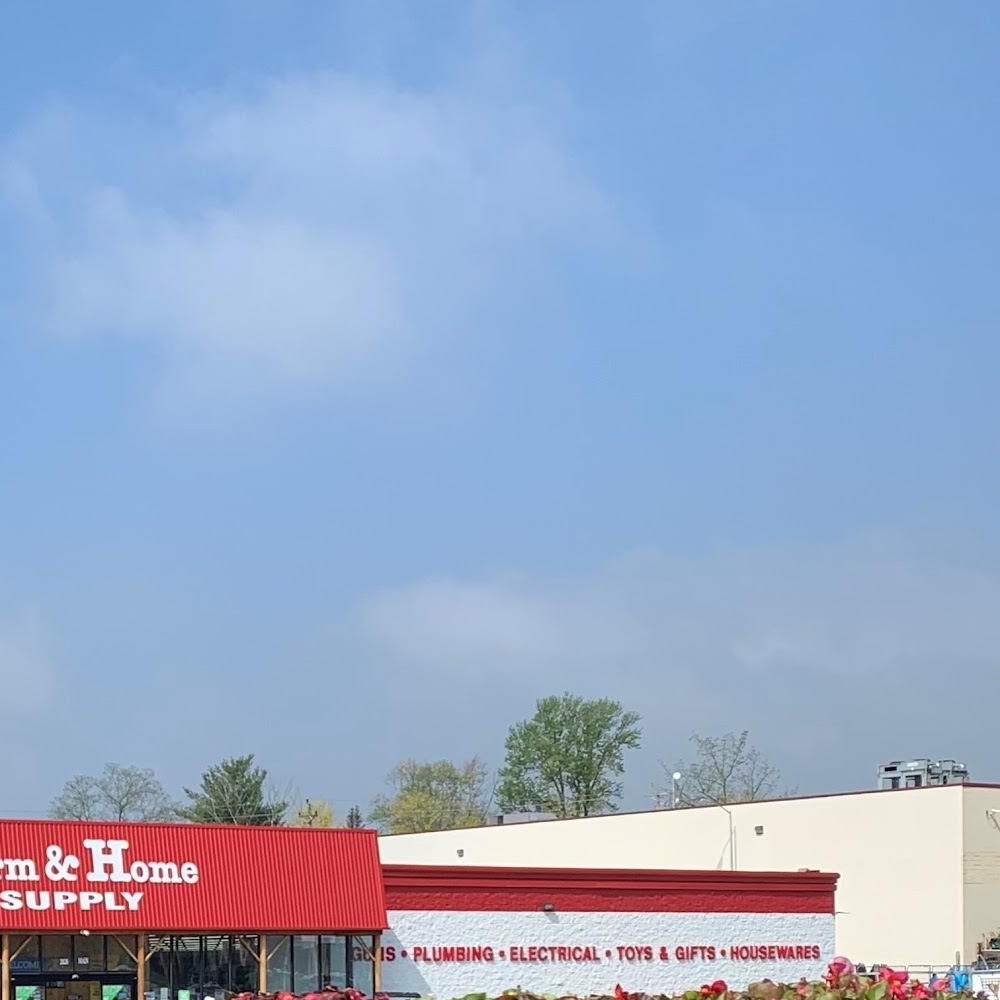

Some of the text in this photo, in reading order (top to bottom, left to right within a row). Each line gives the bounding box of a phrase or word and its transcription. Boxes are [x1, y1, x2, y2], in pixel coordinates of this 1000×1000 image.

[45, 844, 80, 882] &
[83, 838, 199, 884] Home
[0, 890, 144, 911] SUPPLY
[413, 946, 494, 962] PLUMBING
[510, 947, 600, 962] ELECTRICAL
[617, 946, 653, 960] TOYS
[659, 946, 669, 961] &
[675, 946, 716, 961] GIFTS
[730, 945, 820, 960] HOUSEWARES
